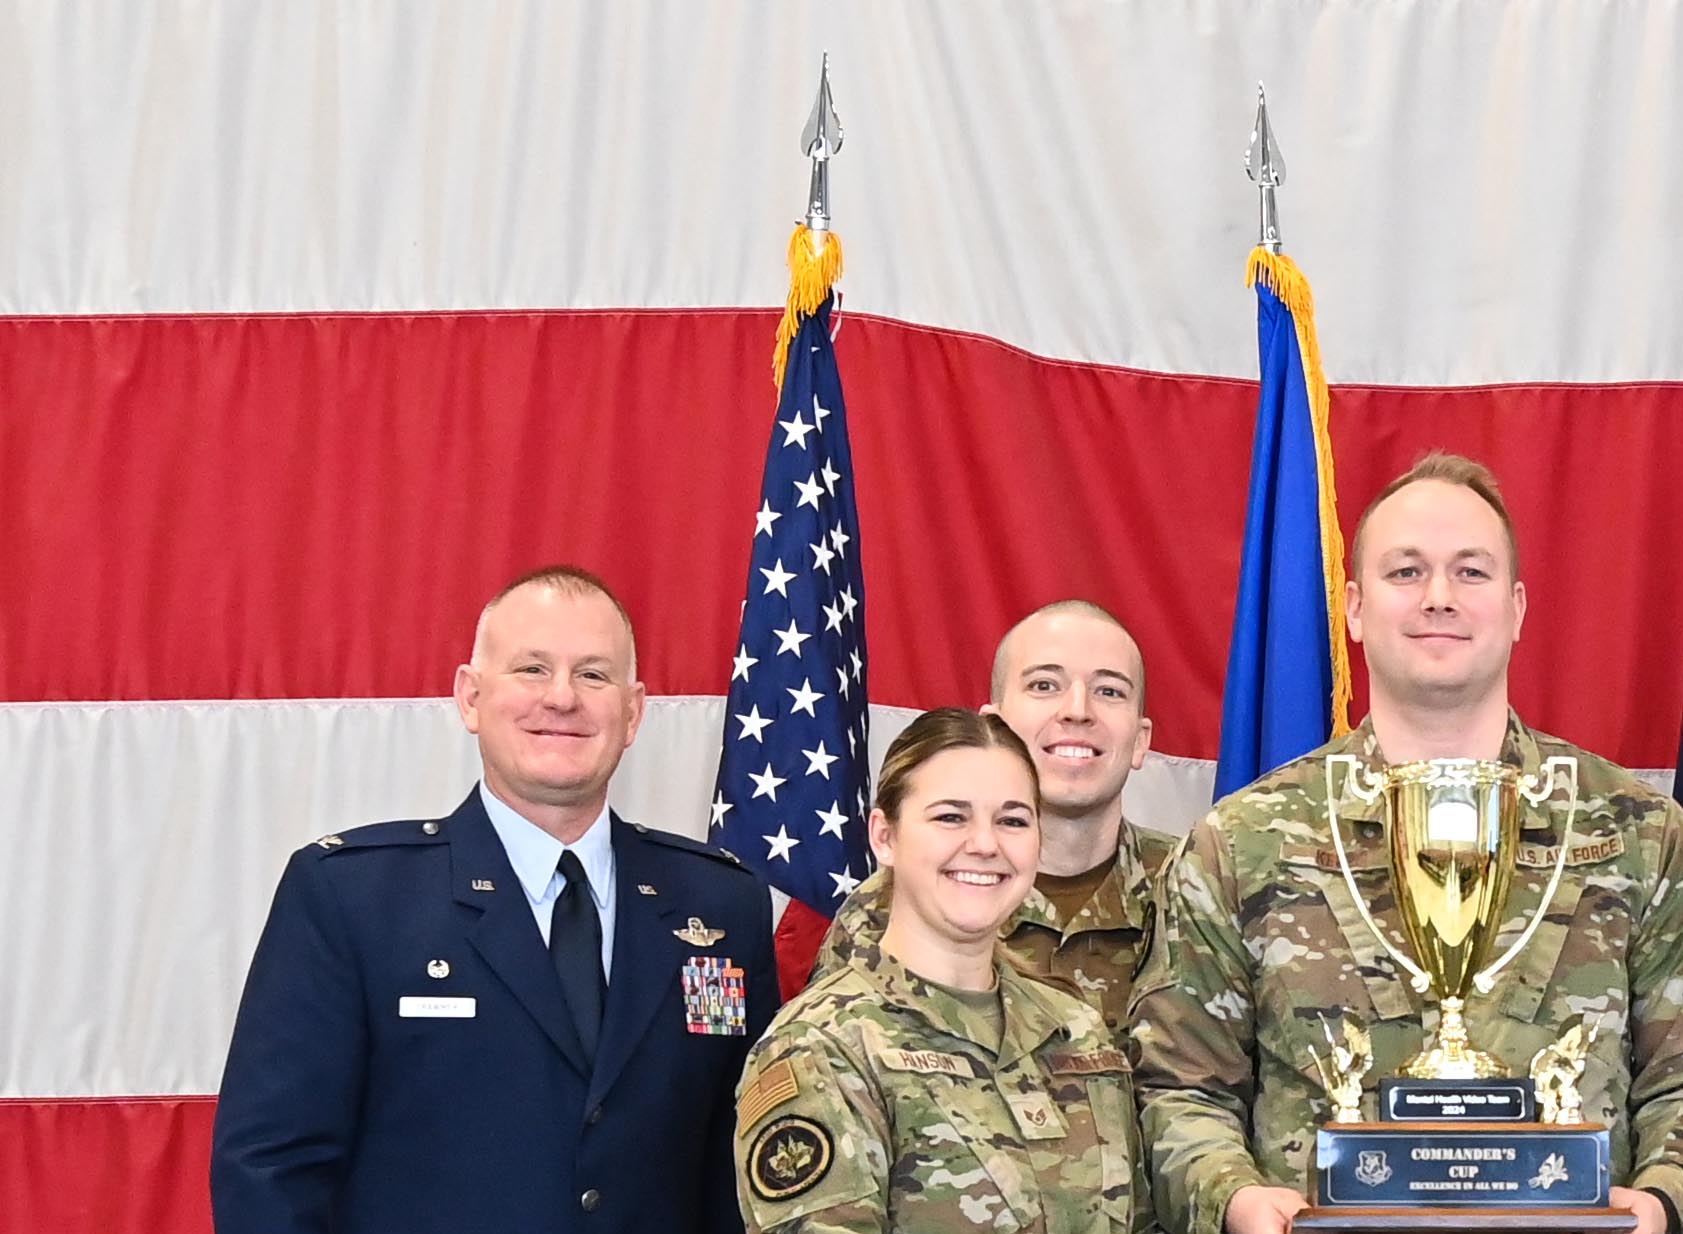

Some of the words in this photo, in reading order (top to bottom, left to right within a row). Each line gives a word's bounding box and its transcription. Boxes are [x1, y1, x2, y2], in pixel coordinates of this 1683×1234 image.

[1572, 838, 1618, 862] FORCE
[899, 1052, 957, 1071] HINSON
[1411, 1147, 1517, 1161] COMMANDER'S
[1448, 1165, 1479, 1178] CUP
[1409, 1181, 1461, 1191] EXCELLENCE
[1463, 1181, 1474, 1191] IN
[1475, 1181, 1490, 1191] ALL
[1491, 1181, 1505, 1191] WE
[1506, 1181, 1519, 1191] DO
